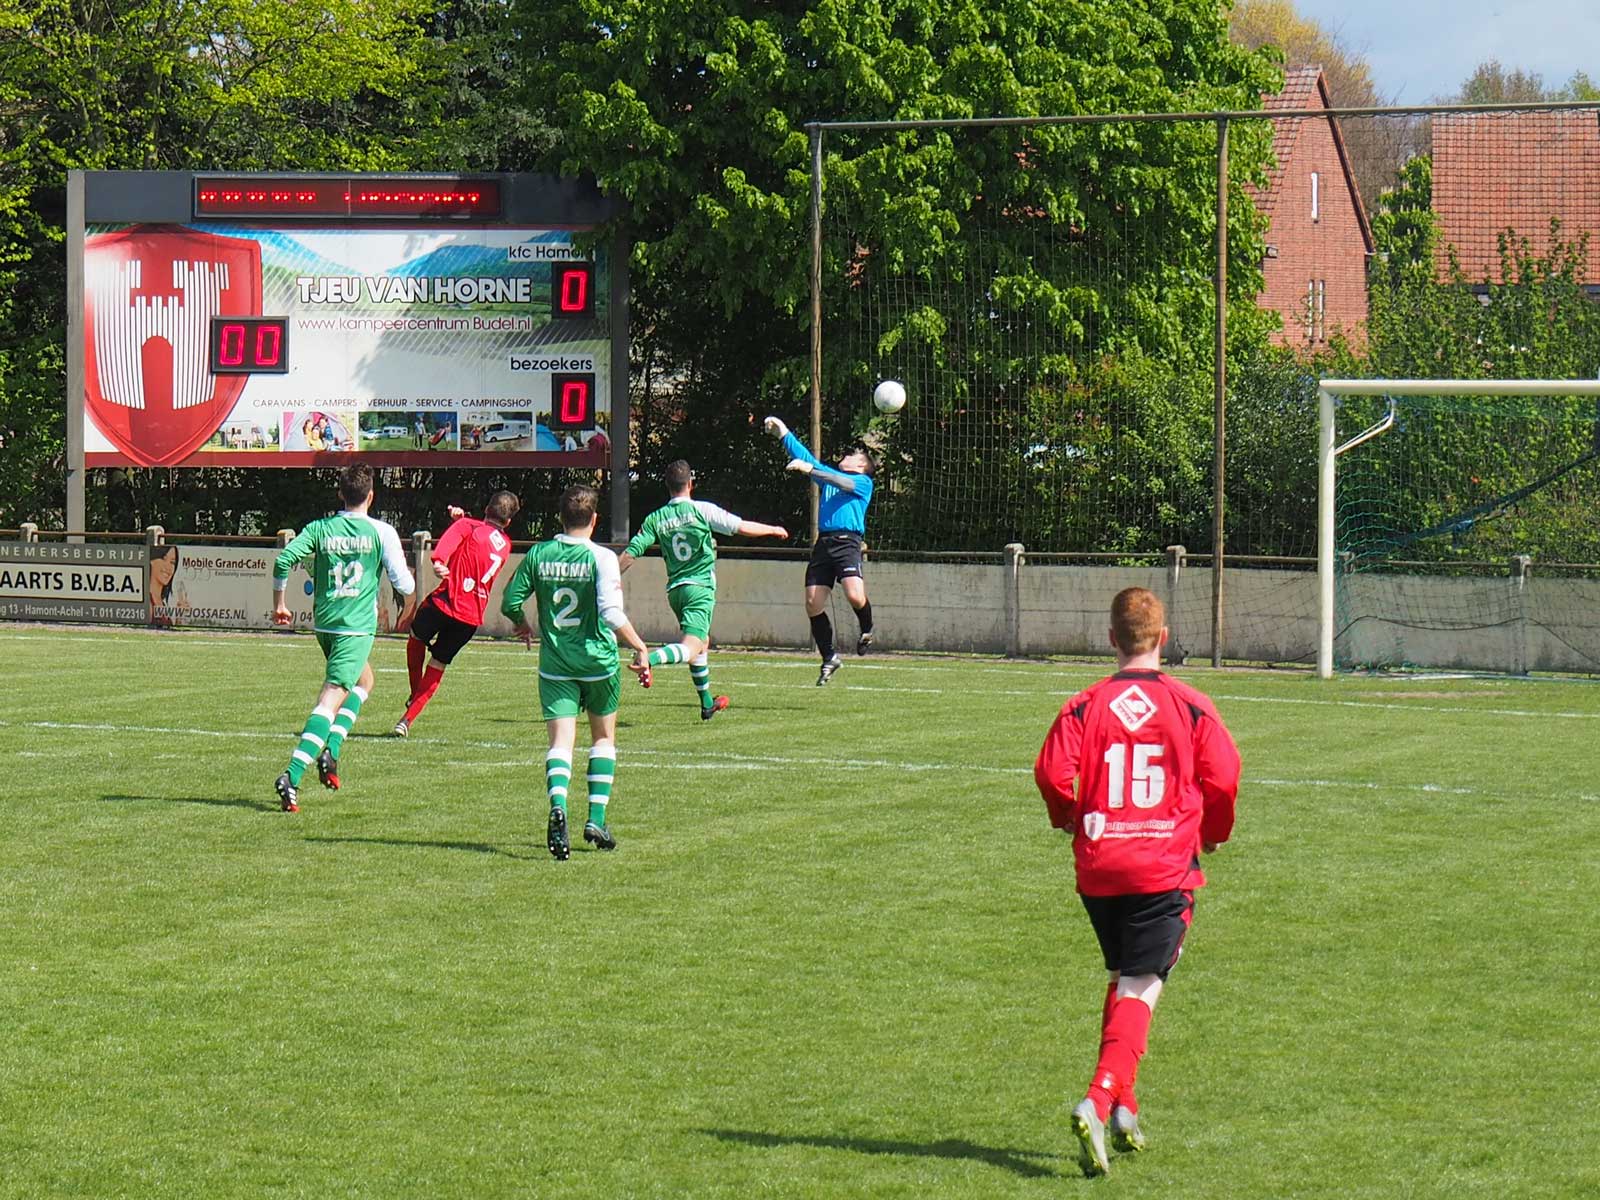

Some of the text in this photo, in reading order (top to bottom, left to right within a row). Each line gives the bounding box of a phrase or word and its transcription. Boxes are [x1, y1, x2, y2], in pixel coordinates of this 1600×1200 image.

[509, 246, 531, 258] kfc
[297, 277, 531, 303] TJEU VAN HORNE
[561, 271, 588, 311] 0
[298, 316, 530, 331] www.kampeercentrum Budel.nl
[220, 324, 281, 366] 00
[511, 357, 592, 370] bezoekers
[367, 399, 408, 407] VERHUUR
[416, 399, 453, 407] SERVICE
[462, 399, 532, 407] CAMPINGSHOP
[561, 382, 588, 423] 0
[672, 533, 692, 561] 6
[182, 557, 266, 569] Mobile Grand-Café
[481, 553, 501, 583] 7
[0, 571, 140, 593] AARTS B.V.B.A.
[328, 560, 363, 598] 12
[9, 603, 18, 614] 13
[25, 604, 83, 617] Hamont-Achel
[90, 607, 98, 618] T.
[100, 608, 113, 618] 011
[553, 587, 581, 627] 2
[1104, 743, 1165, 808] 15
